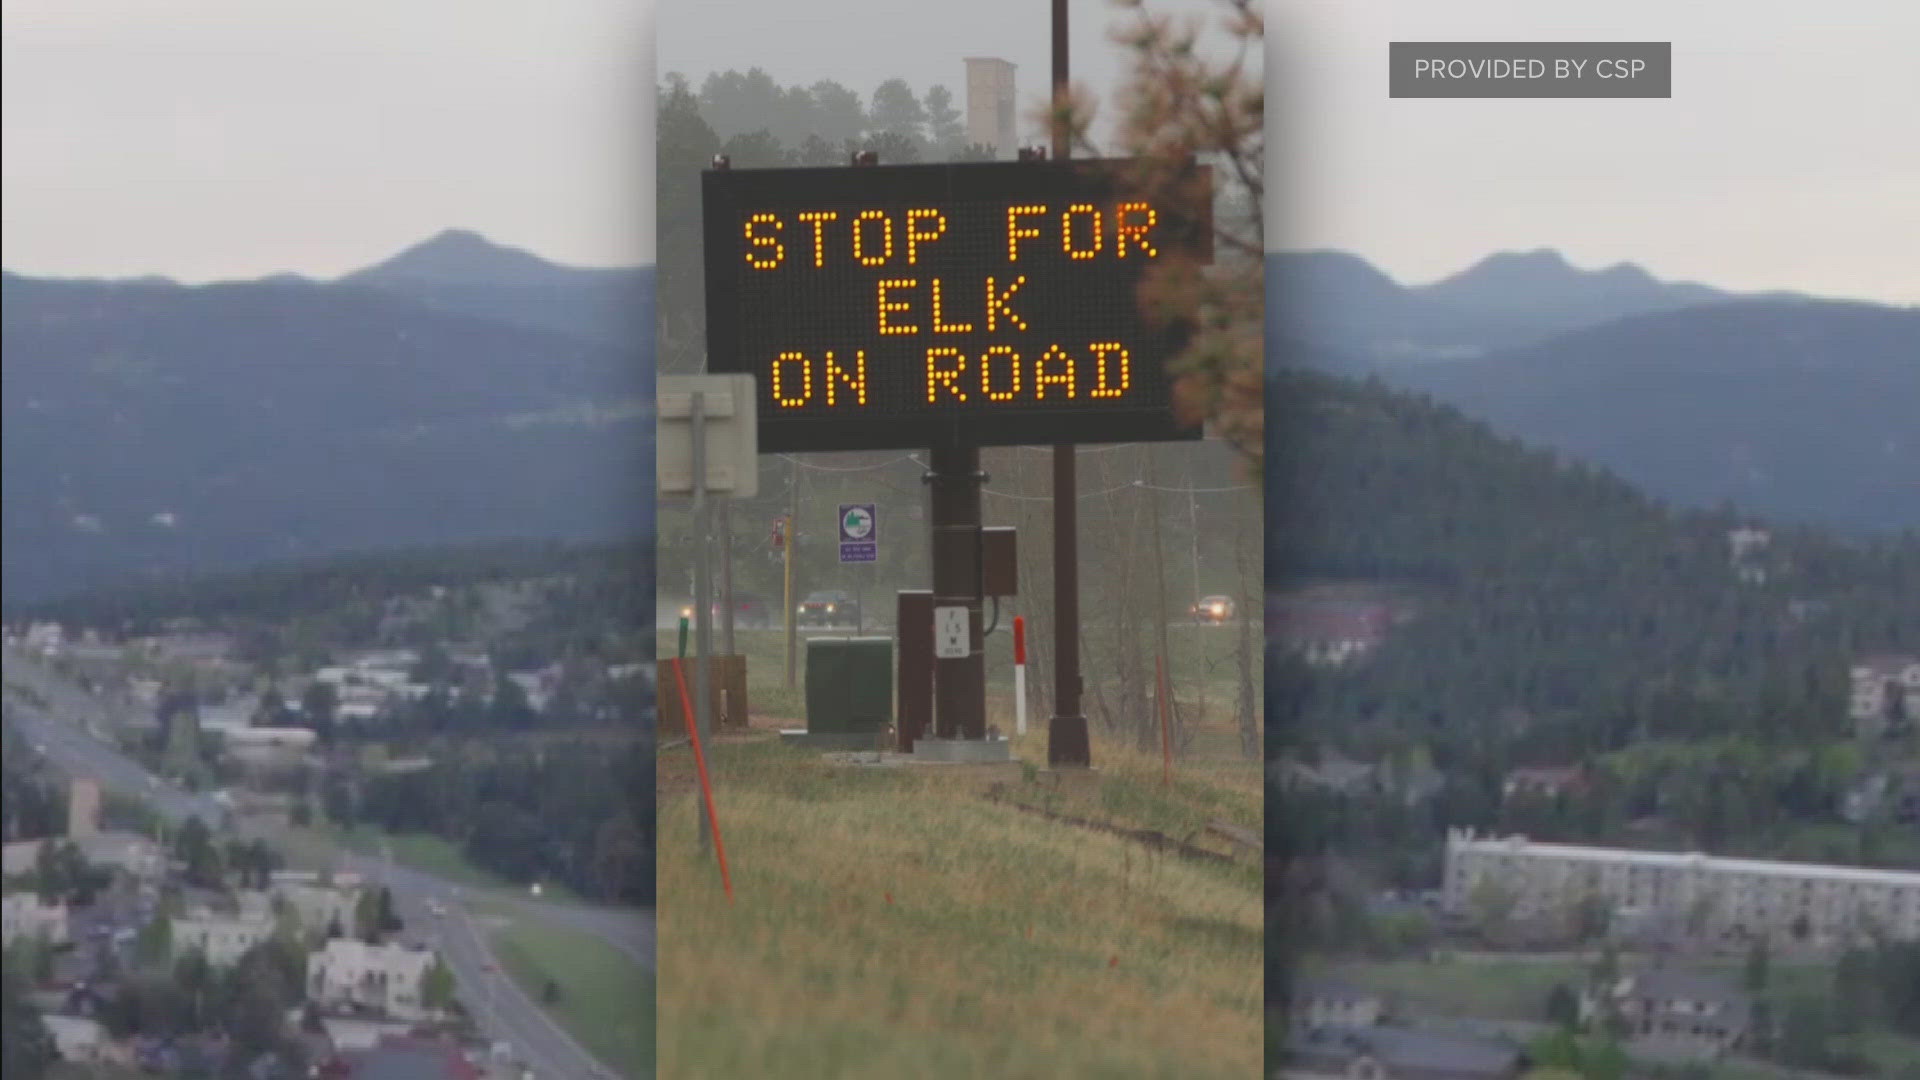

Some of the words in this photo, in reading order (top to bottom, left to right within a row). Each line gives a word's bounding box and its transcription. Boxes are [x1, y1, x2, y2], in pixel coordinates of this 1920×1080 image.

[745, 208, 947, 269] STOP
[1007, 201, 1157, 261] FOR
[878, 275, 1027, 335] ELK
[772, 350, 866, 407] ON
[926, 342, 1129, 403] ROAD
